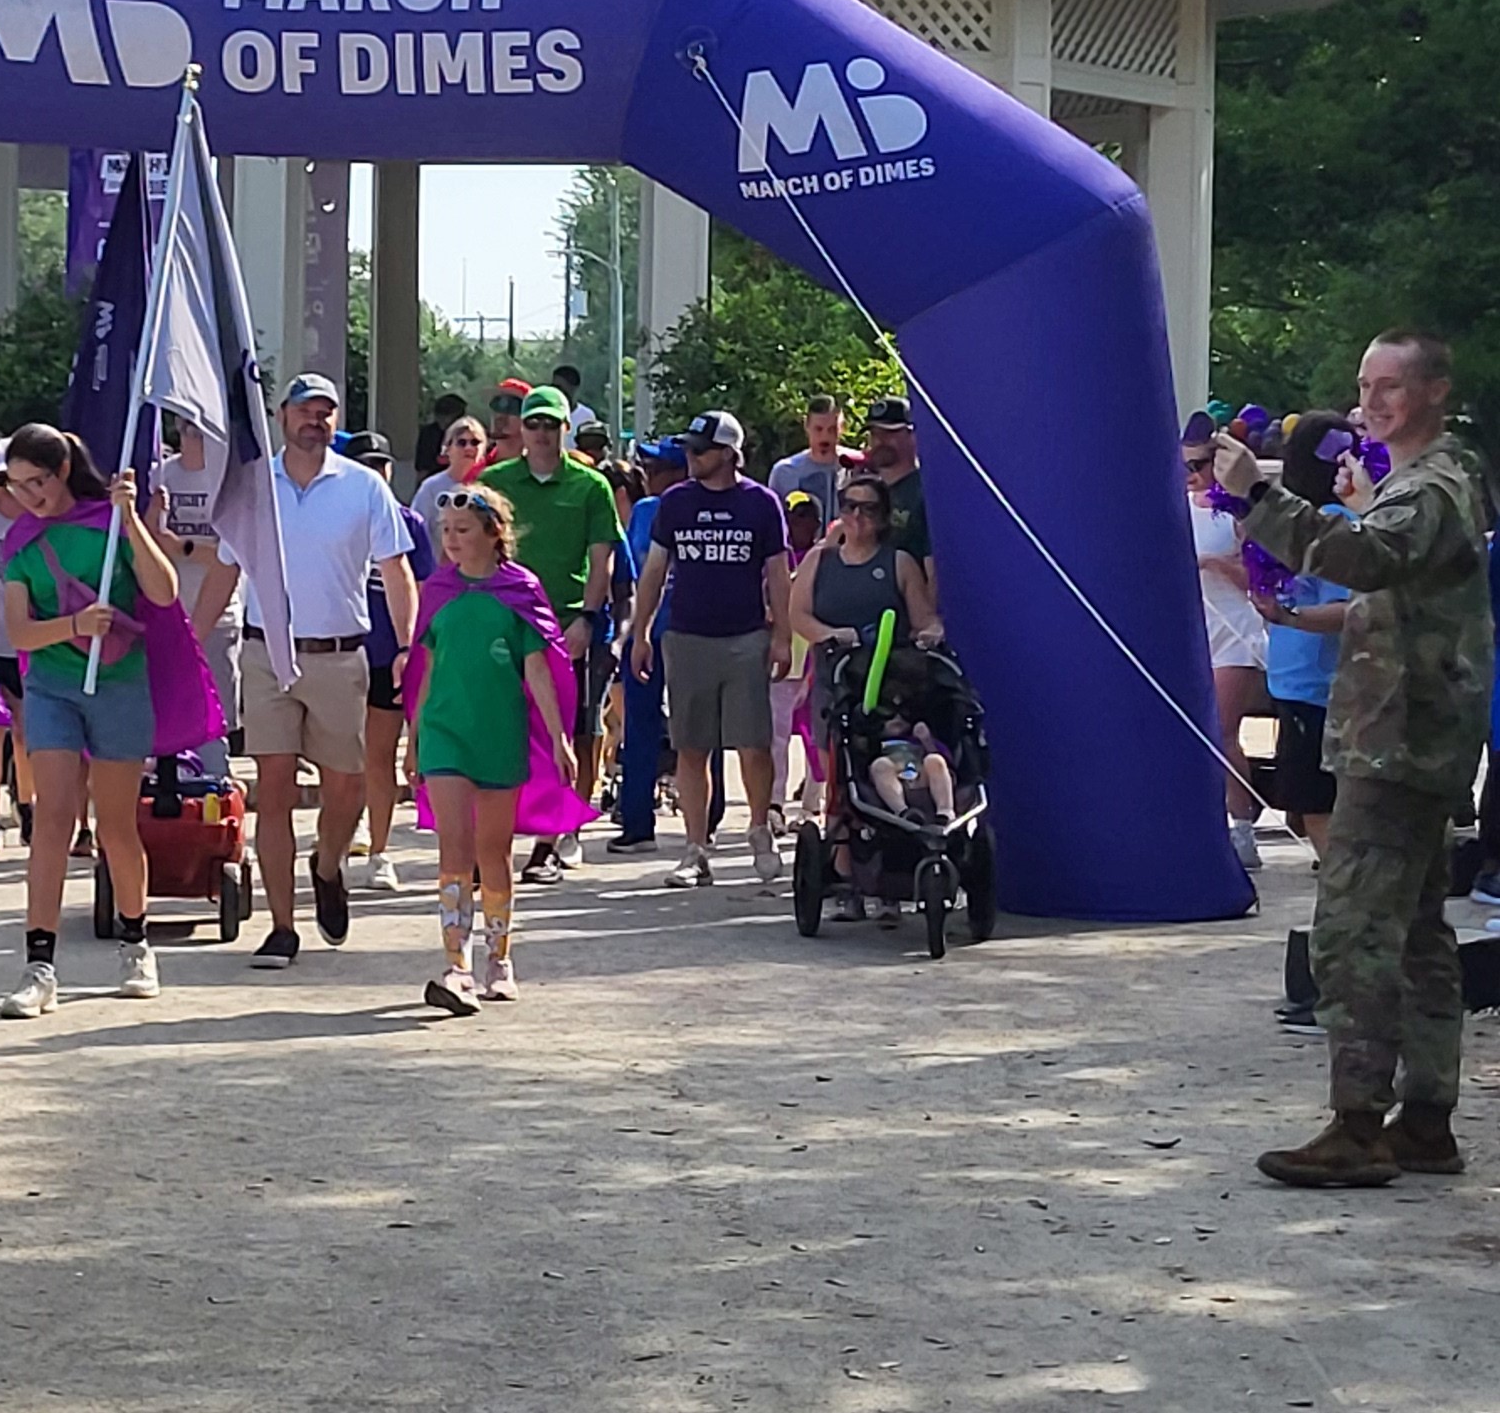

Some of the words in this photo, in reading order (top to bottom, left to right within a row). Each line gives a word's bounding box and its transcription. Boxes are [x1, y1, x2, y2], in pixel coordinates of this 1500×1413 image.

[221, 29, 319, 94] OF
[339, 29, 584, 95] DIMES
[739, 174, 820, 199] MARCH
[823, 169, 854, 191] OF
[858, 157, 936, 186] DIMES
[674, 529, 724, 543] MARCH
[725, 529, 753, 543] FOR
